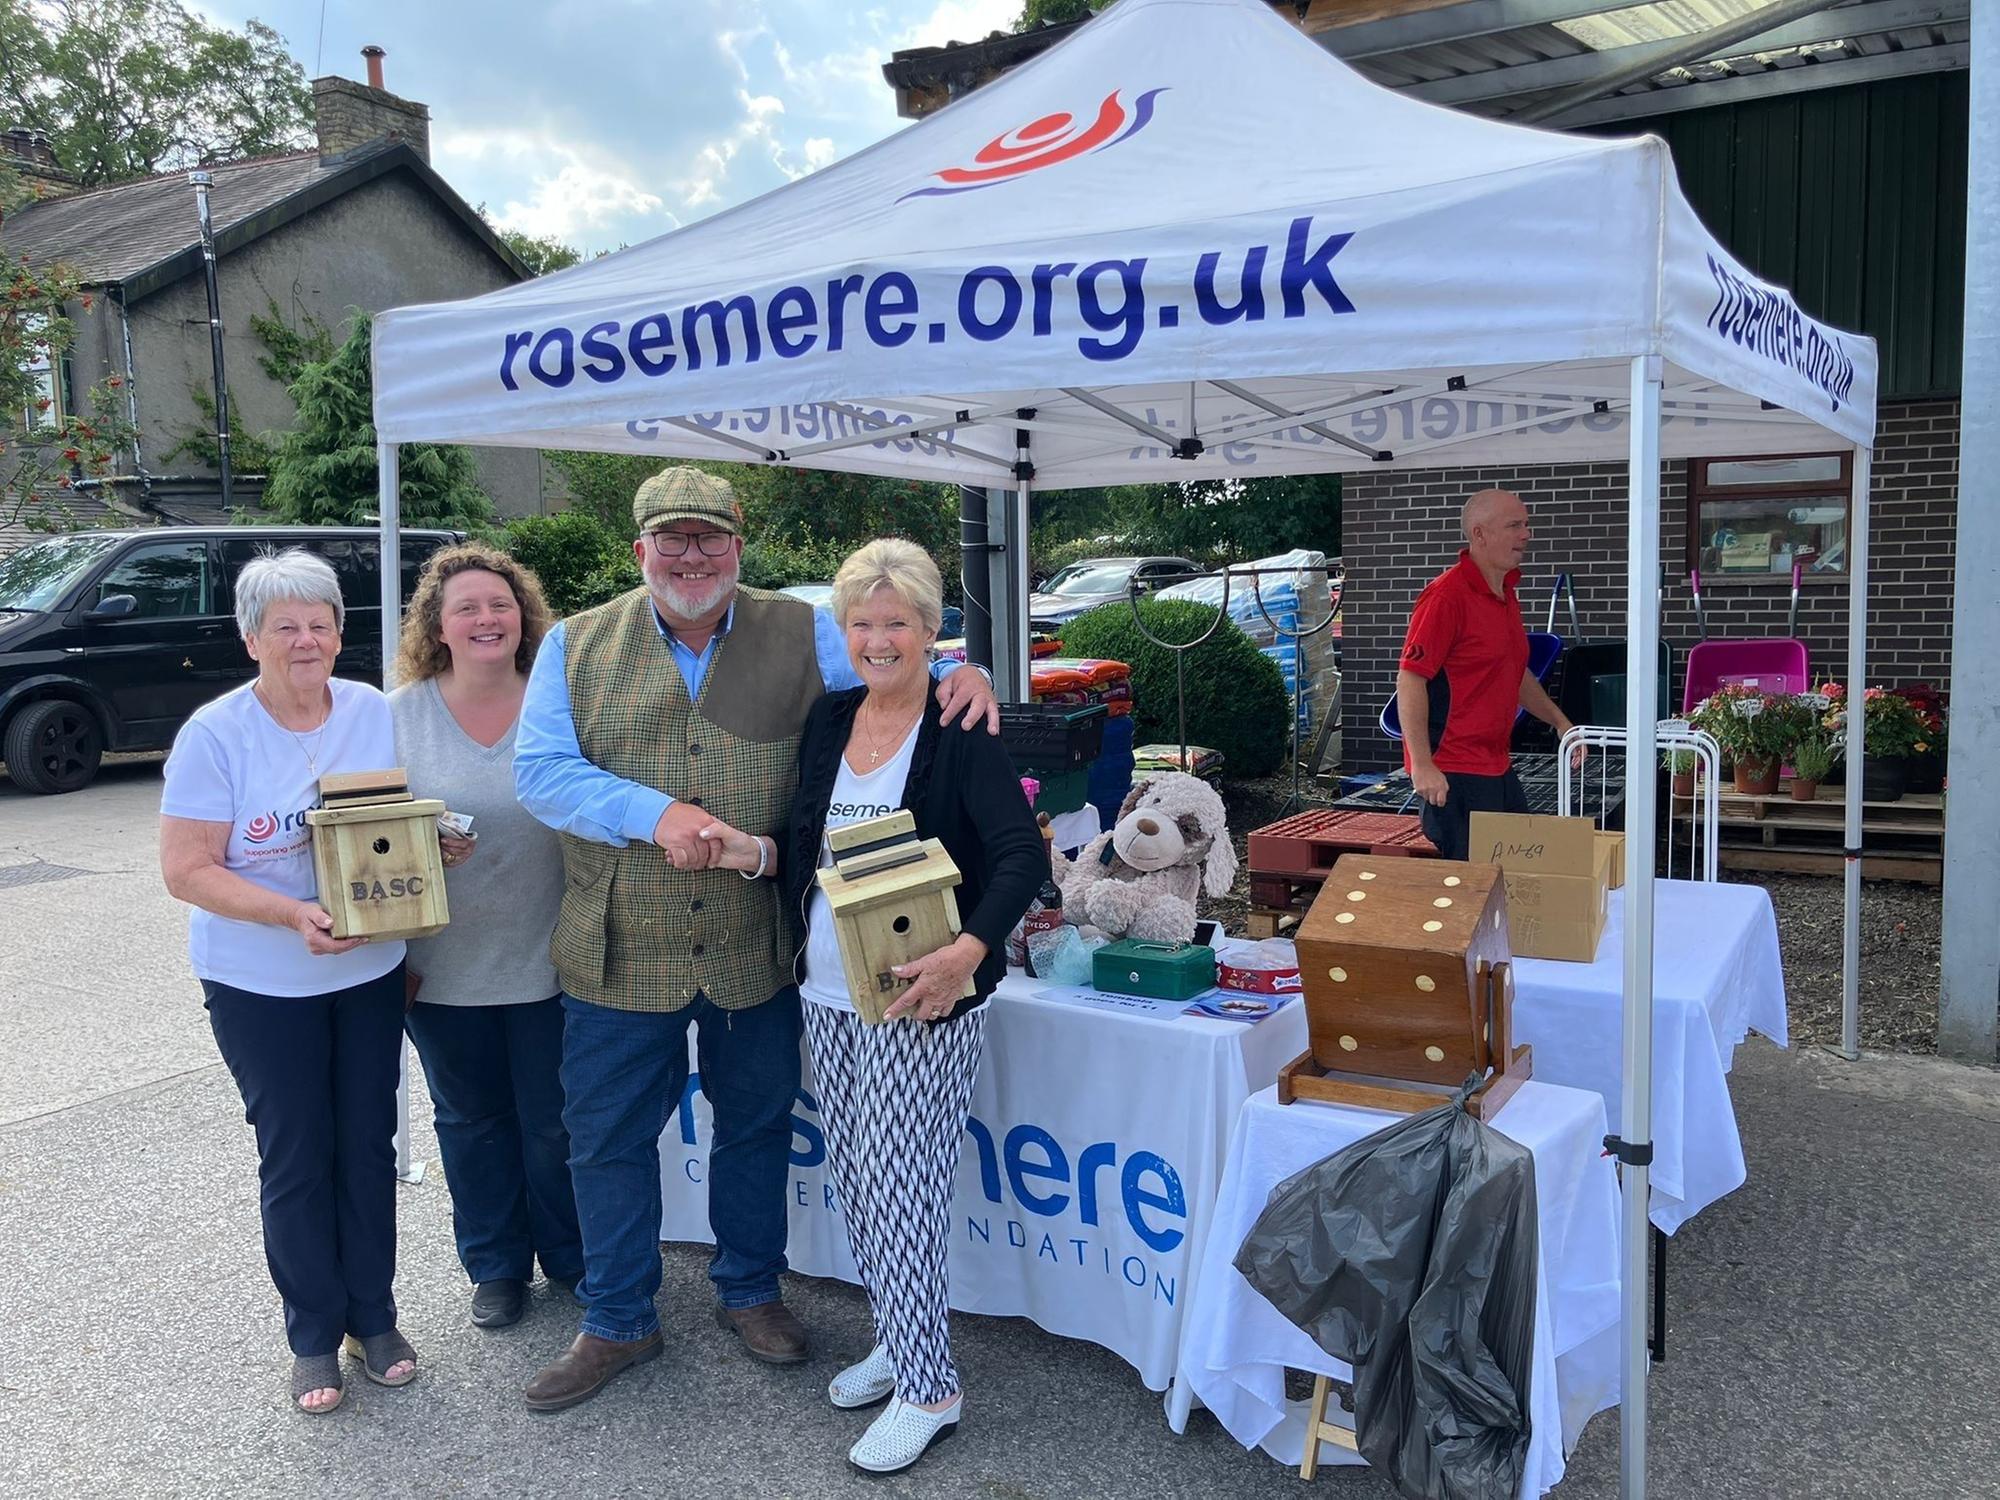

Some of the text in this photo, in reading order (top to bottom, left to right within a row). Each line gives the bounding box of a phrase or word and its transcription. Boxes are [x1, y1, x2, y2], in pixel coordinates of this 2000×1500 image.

[500, 216, 1357, 391] rosemere.org.uk
[350, 876, 424, 901] BASC
[967, 1215, 1176, 1307] NDATION
